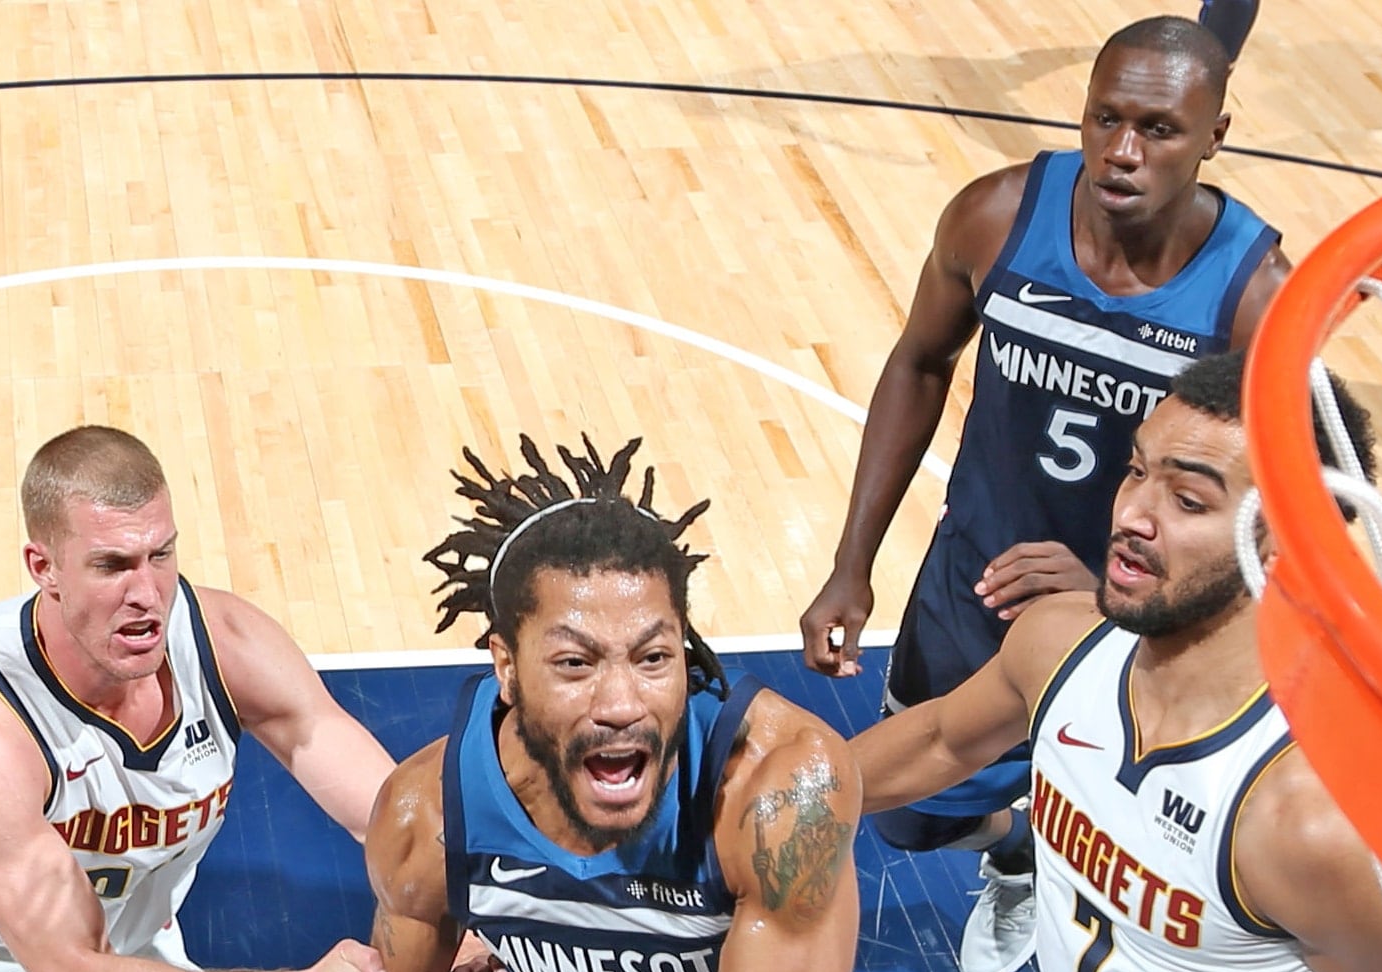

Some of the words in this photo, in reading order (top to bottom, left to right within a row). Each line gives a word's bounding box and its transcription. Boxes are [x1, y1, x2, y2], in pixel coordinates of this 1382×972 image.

[1154, 328, 1197, 353] fitbit
[989, 332, 1167, 421] MINNESOT
[1039, 408, 1099, 482] 5
[188, 746, 217, 766] UNION
[1162, 788, 1206, 834] WU
[1154, 815, 1196, 847] WESTERN
[1163, 832, 1194, 855] UNION
[1030, 769, 1207, 950] NUGGETS
[652, 881, 704, 908] fitbit
